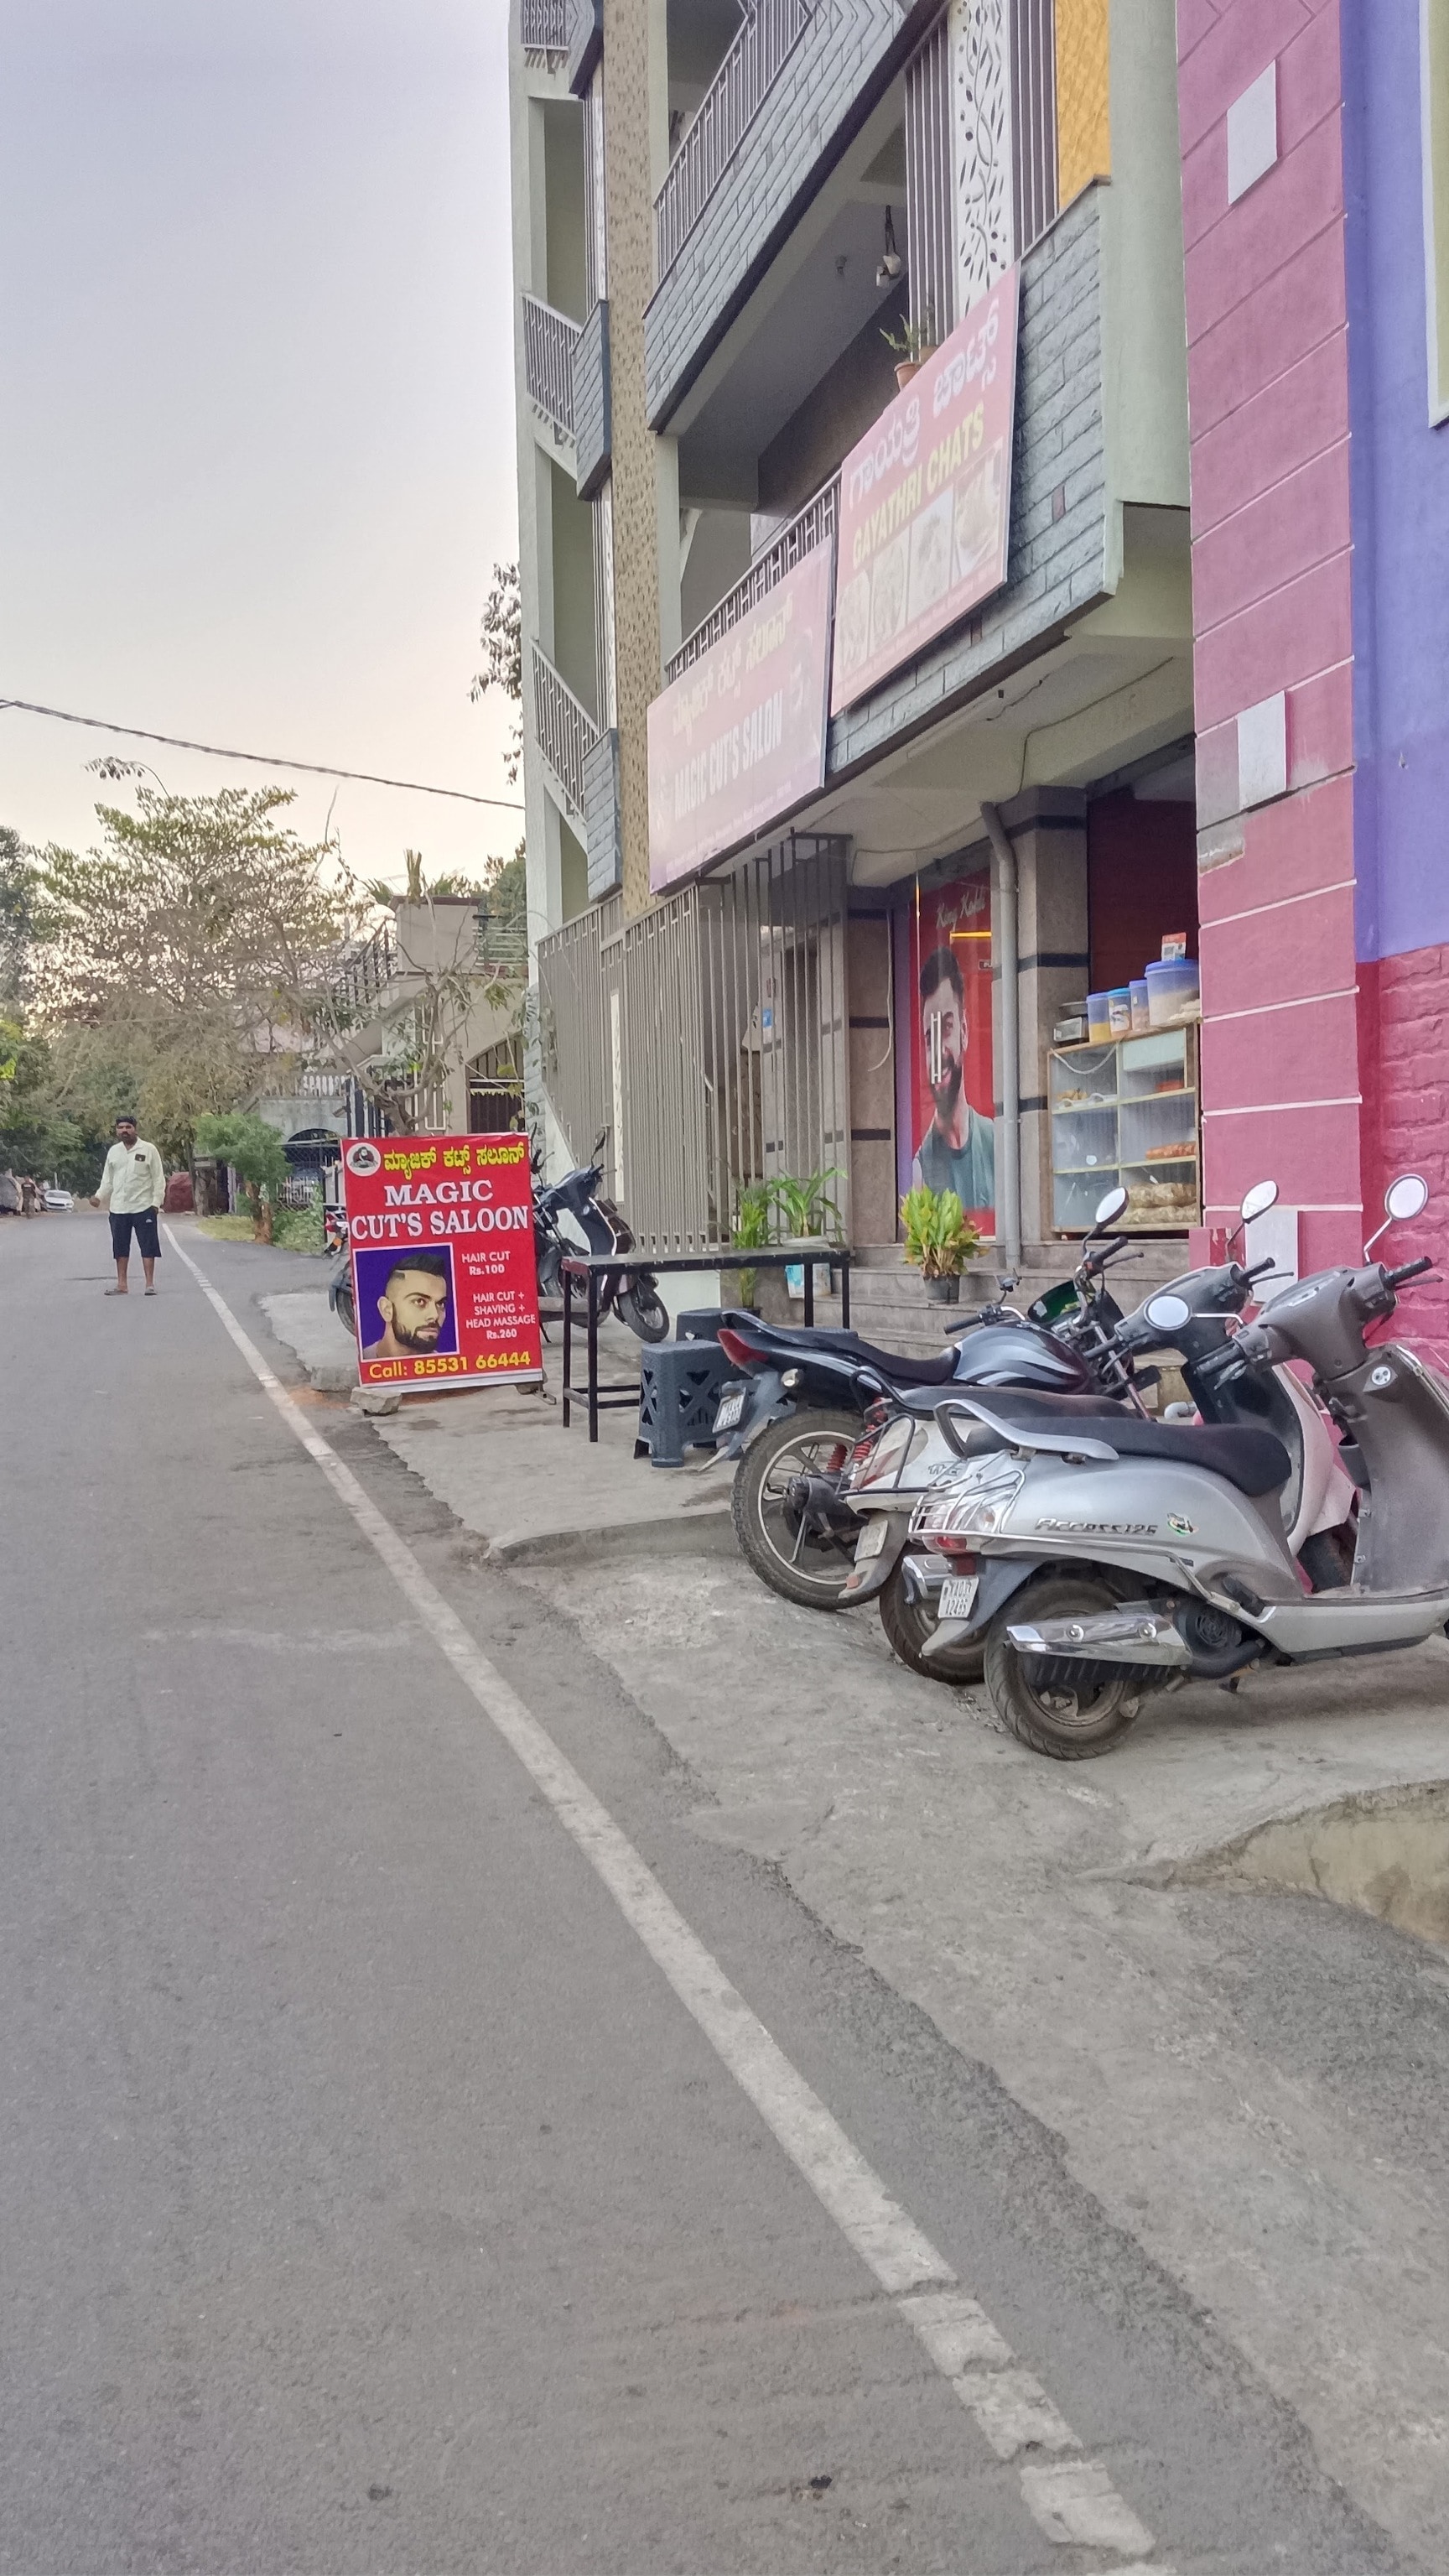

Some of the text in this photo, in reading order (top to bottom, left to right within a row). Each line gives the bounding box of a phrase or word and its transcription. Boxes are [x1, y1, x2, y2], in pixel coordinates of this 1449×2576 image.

[852, 465, 922, 570] GAYATHRI
[926, 399, 984, 496] CHATS
[674, 688, 783, 822] MAGIC CUT'S SALON
[384, 1141, 525, 1180] ಮ್ಯಾಜಿಕ್ ಕಟ್ಸ್ ಸಲೂನ್
[384, 1179, 493, 1206] MAGIC
[351, 1205, 528, 1240] CUT'S SALOON
[461, 1251, 511, 1263] HAIR CUT
[469, 1264, 505, 1276] Rs.100
[472, 1292, 495, 1303] HAIR
[496, 1290, 515, 1301] CUT
[474, 1303, 516, 1316] SHAVING
[465, 1314, 536, 1329] HEAD MASSAGE
[486, 1328, 517, 1340] Rs.260
[369, 1351, 530, 1378] Call: 85531 66444
